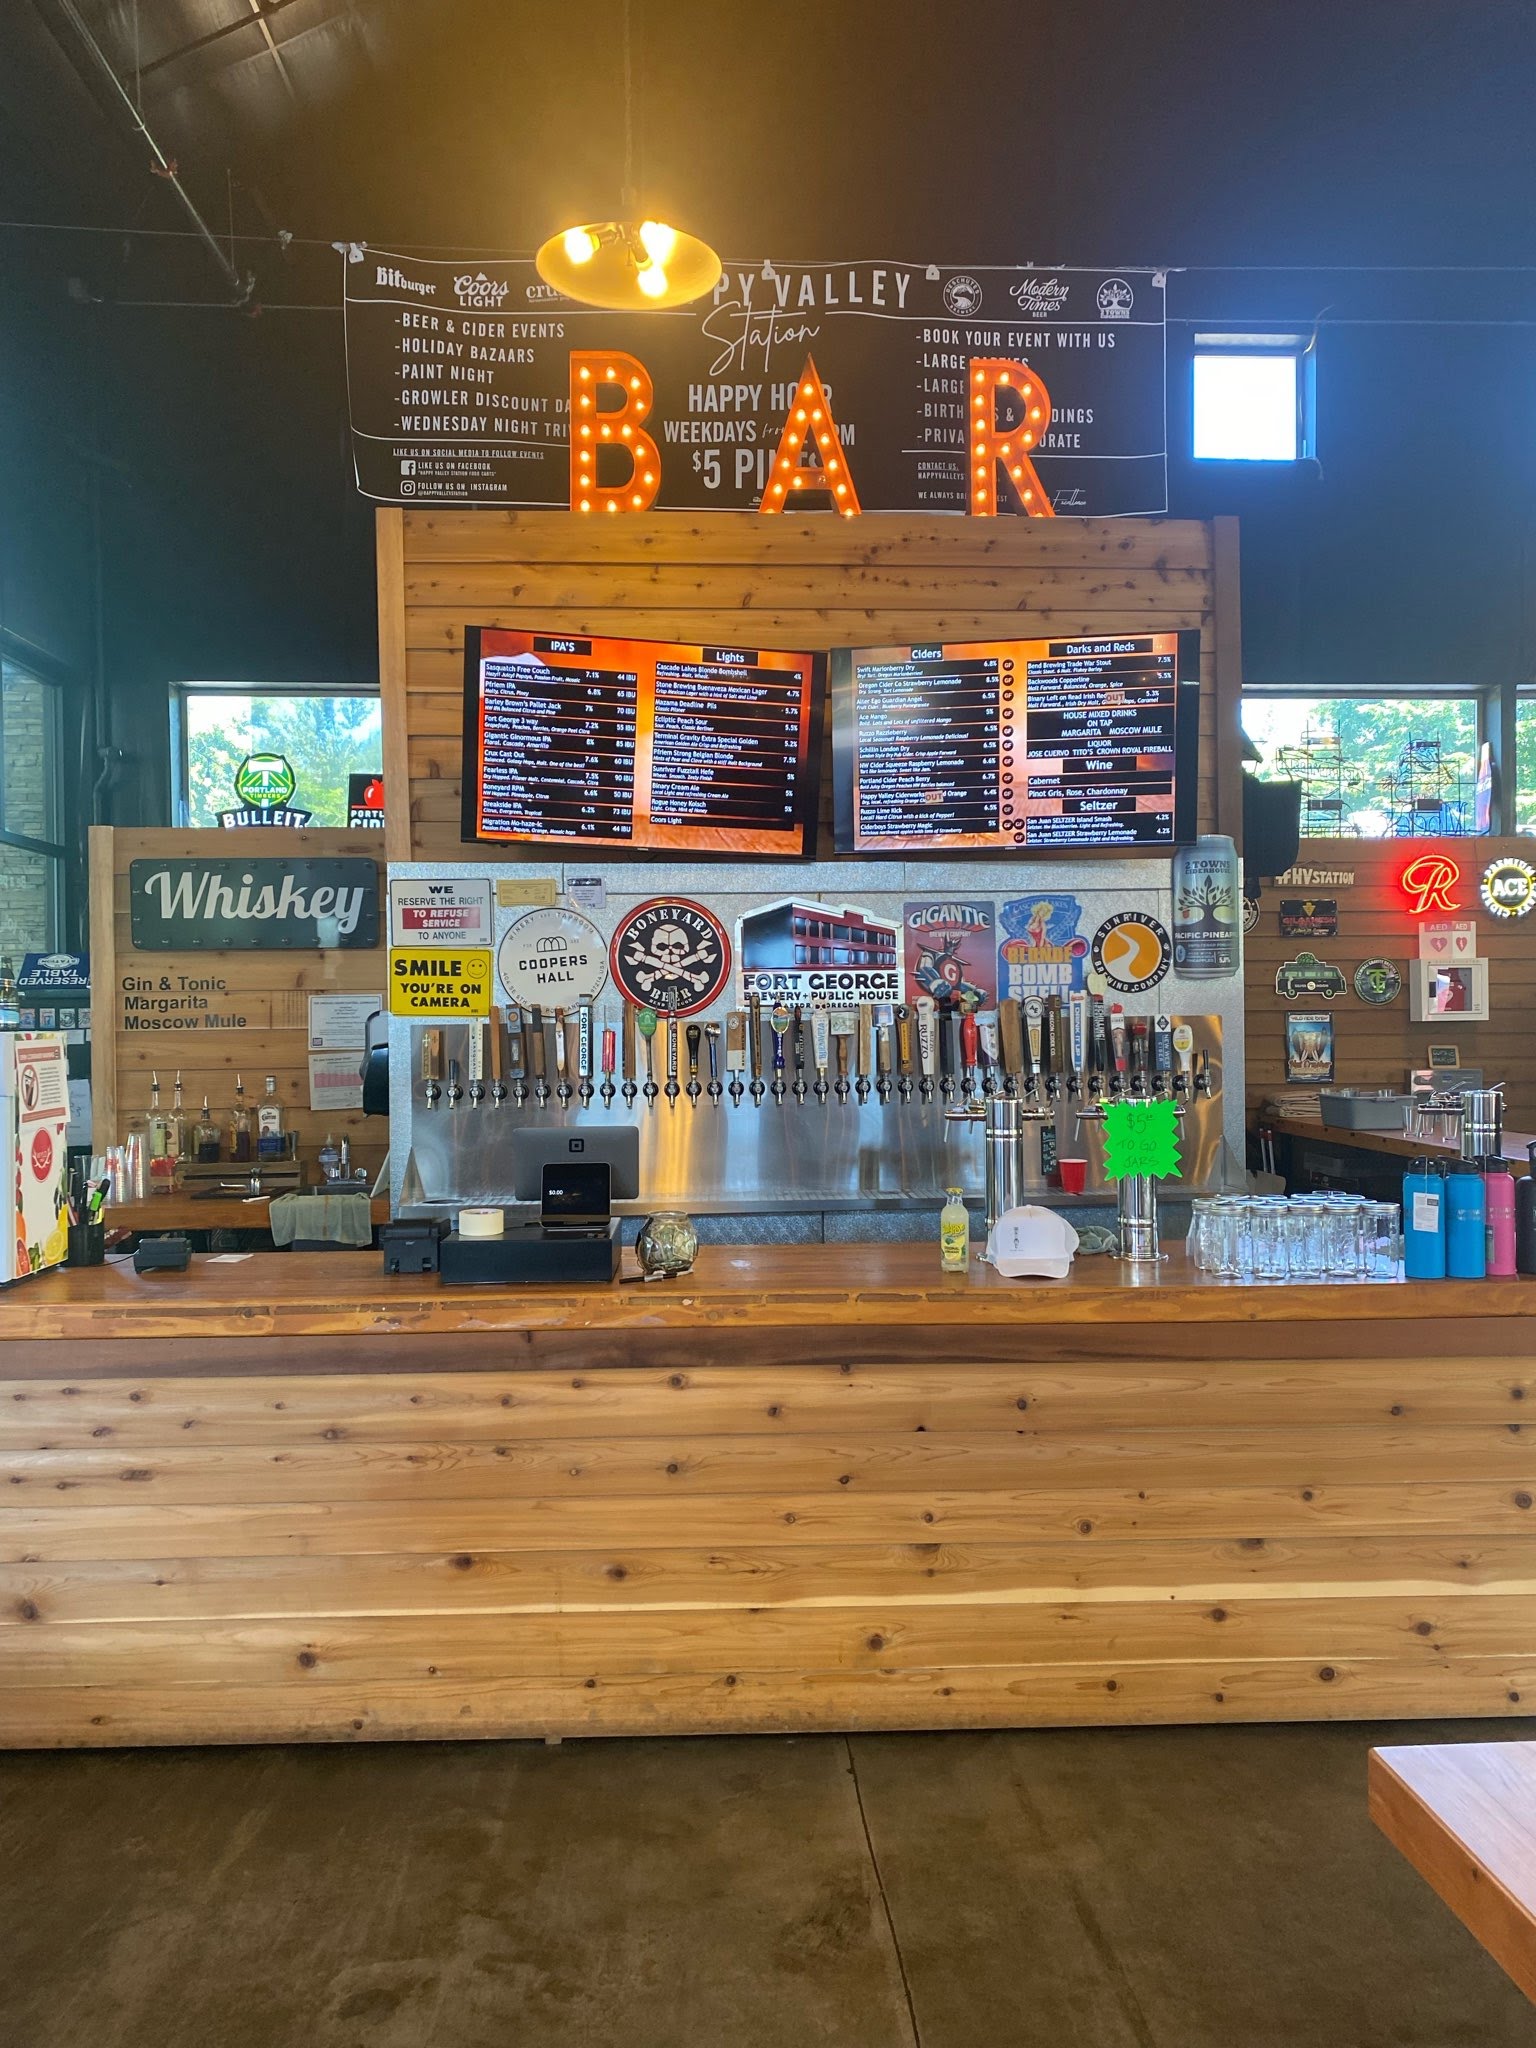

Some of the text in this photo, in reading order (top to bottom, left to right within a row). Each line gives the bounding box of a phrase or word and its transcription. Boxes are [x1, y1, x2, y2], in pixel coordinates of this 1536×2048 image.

[453, 275, 510, 296] Coors
[774, 269, 911, 308] VALLEY
[1009, 278, 1070, 300] Modern
[459, 296, 503, 307] LIGHT
[1017, 295, 1061, 311] Times
[446, 319, 455, 334] &
[462, 321, 506, 338] CIDER
[512, 323, 565, 338] EVENTS
[702, 301, 820, 376] Station
[965, 330, 1001, 346] YOUR
[1008, 332, 1051, 348] EVENT
[1057, 333, 1091, 348] WITH
[1098, 333, 1116, 348] US
[470, 345, 535, 363] BAZAARS
[450, 365, 494, 384] NIGHT
[476, 392, 549, 413] DISCOUNT
[688, 383, 762, 413] HAPPY
[494, 419, 538, 436] NIGHT
[664, 420, 757, 443] WEEKDAYS
[418, 462, 433, 470] LIKE
[435, 462, 444, 470] US
[692, 449, 721, 490] $5
[418, 482, 443, 490] FOLLOW
[456, 483, 466, 491] ON
[911, 649, 942, 659] Ciders
[1066, 642, 1135, 654] Darks and Reds
[716, 651, 745, 663] Lights
[1063, 709, 1137, 719] HOUSE MIXED DRINKS
[1087, 719, 1113, 727] ON TAP
[1061, 726, 1162, 738] MARGARITA MOSCOW MULE
[1087, 740, 1112, 748] LIQUOR
[1028, 750, 1043, 758] JOSE
[1044, 749, 1070, 757] CUERVO
[1121, 746, 1142, 754] ROYAL
[1086, 760, 1113, 771] Wine
[1029, 777, 1061, 785] Cabernet
[243, 786, 287, 794] PORTLAND
[1028, 789, 1047, 797] Pinot
[1086, 787, 1128, 796] Chardonnay
[1080, 801, 1118, 811] Seltzer
[222, 810, 305, 828] BULLEIT
[651, 816, 682, 825] Coors Light
[428, 886, 454, 894] WE
[1402, 854, 1461, 914] R
[1492, 878, 1528, 897] ACE
[144, 871, 364, 934] Whiskey
[398, 896, 484, 906] RESERVE THE RIGHT
[413, 909, 469, 918] TO REFUSE
[908, 904, 990, 928] GIGANTIC
[422, 919, 460, 927] SERVICE
[626, 909, 713, 940] BONEYARD
[1098, 913, 1164, 938] SUNRIVER
[418, 931, 466, 940] TO ANYONE
[394, 959, 462, 977] SMILE
[519, 954, 588, 971] COOPERS
[537, 971, 574, 984] HALL
[743, 973, 899, 990] FORT GEORGE
[1008, 964, 1072, 985] BOMB
[122, 976, 226, 991] Gin & Tonic
[401, 983, 481, 994] YOU'RE ON
[411, 997, 470, 1008] CAMERA
[744, 991, 801, 1001] BREWERY
[811, 991, 854, 1000] PUBLIC
[859, 991, 899, 1000] HOUSE
[124, 996, 208, 1013] Margarita
[124, 1014, 247, 1030] Moscow Mule
[920, 1024, 929, 1060] RUZZO
[1124, 1156, 1159, 1168] JARS
